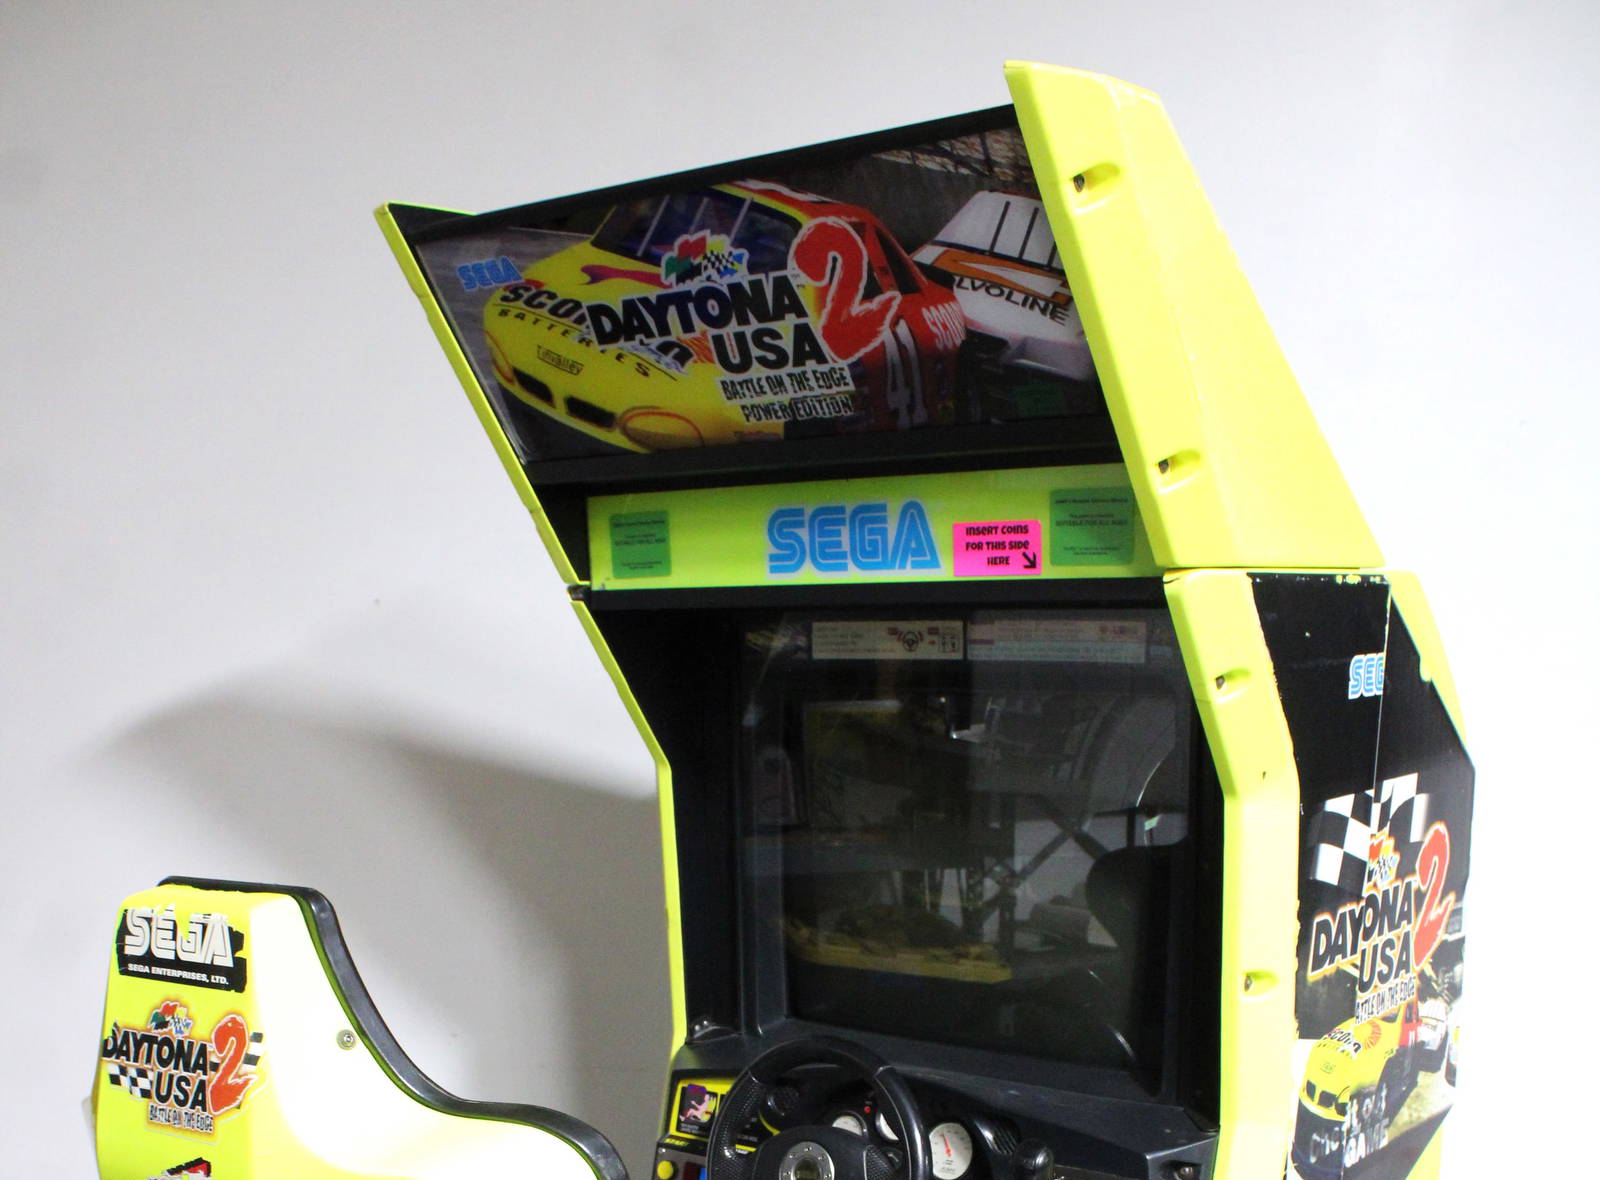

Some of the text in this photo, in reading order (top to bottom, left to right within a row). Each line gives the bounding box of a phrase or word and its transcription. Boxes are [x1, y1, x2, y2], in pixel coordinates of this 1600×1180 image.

[457, 257, 522, 291] SEGA
[793, 217, 901, 363] 2
[586, 275, 807, 345] DAYTONA
[712, 323, 828, 374] USA
[720, 367, 850, 401] BATTLE ON THE EDGE
[741, 395, 855, 422] POWER EDITION
[768, 500, 941, 574] SEGA
[965, 539, 1030, 551] FOR THIS SIDE
[1001, 524, 1029, 535] COINS
[987, 556, 1010, 566] HERE
[1415, 822, 1456, 969] 2
[123, 904, 234, 967] SEGA
[127, 963, 229, 985] SEGA ENTERPRISES, LTD.
[1358, 930, 1411, 993] USA
[1376, 989, 1386, 1015] ON
[1388, 984, 1399, 1009] THE
[1399, 976, 1416, 1002] EDGE
[101, 1026, 208, 1076] DAYTONA
[210, 1015, 258, 1114] 2
[155, 1070, 208, 1112] USA
[149, 1104, 171, 1123] BATTLE
[184, 1111, 195, 1129] THE
[196, 1113, 214, 1132] EDGE
